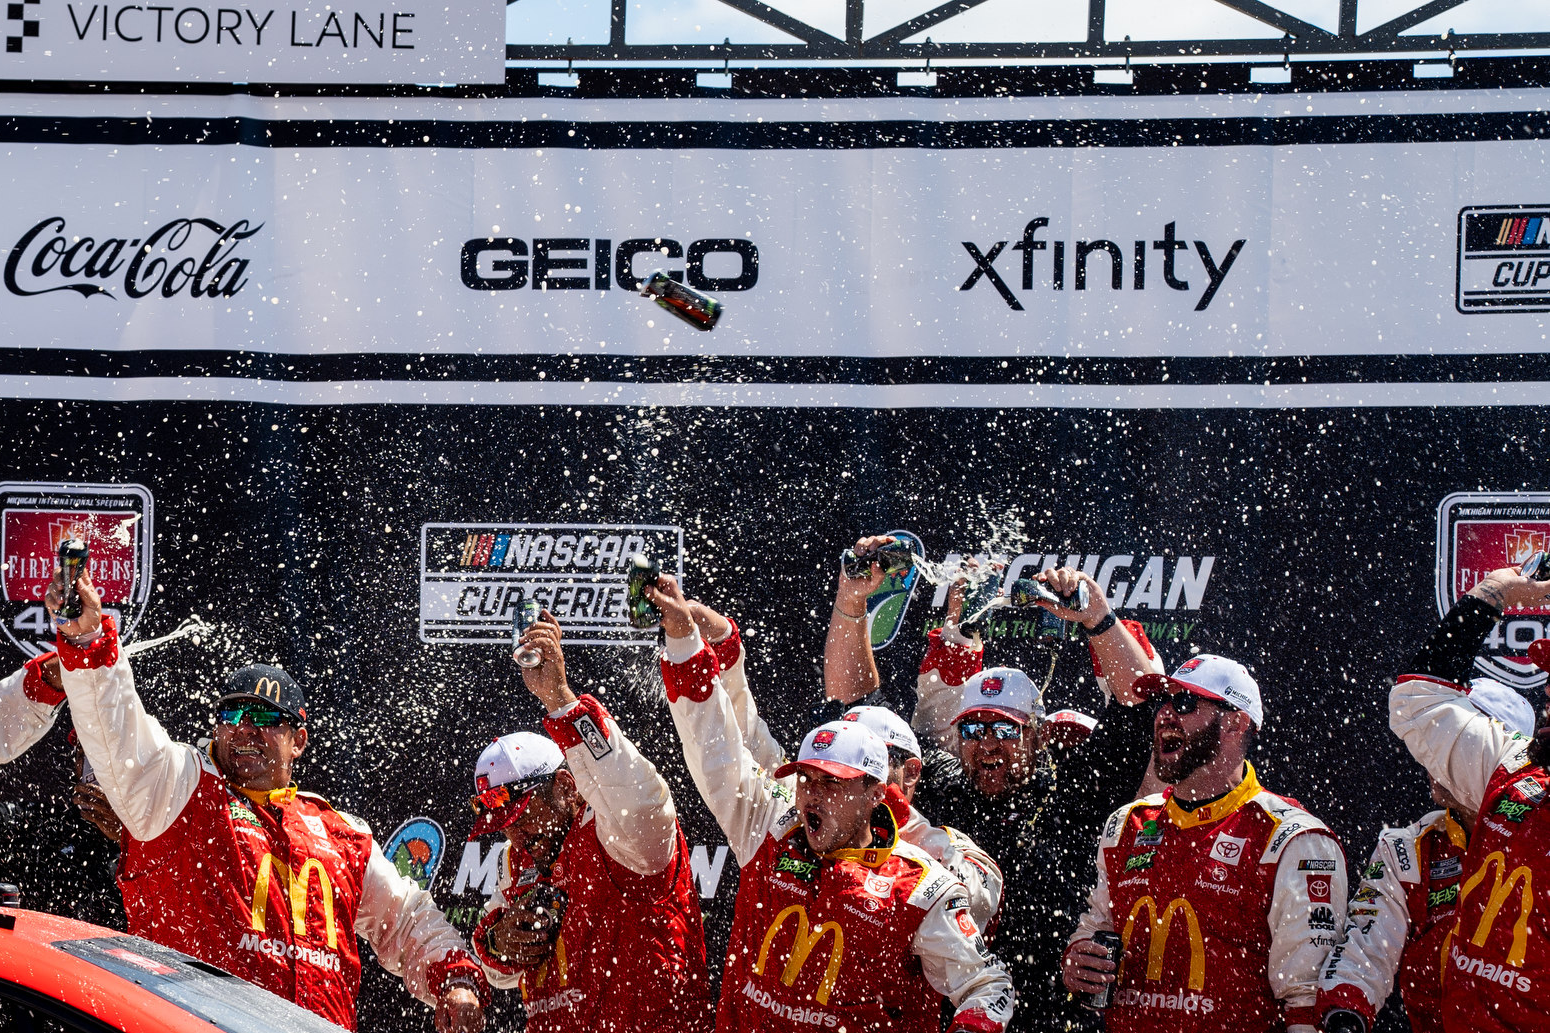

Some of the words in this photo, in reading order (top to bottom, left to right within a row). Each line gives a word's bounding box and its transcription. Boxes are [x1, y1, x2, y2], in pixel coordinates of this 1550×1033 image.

[68, 4, 274, 46] VICTORY
[291, 11, 415, 49] LANE
[3, 216, 266, 300] Coca-Cola
[460, 237, 760, 291] GEICO
[959, 216, 1247, 311] xfinity
[1493, 507, 1550, 516] INTERNATIONA
[503, 534, 646, 568] NASCAR
[529, 585, 631, 618] SERIE
[1496, 799, 1532, 817] BEAST
[775, 856, 819, 875] BEAST
[1309, 860, 1336, 871] NASCAR
[768, 875, 808, 897] GOODYEAR
[1194, 879, 1241, 896] MoneyLion
[741, 980, 838, 1028] McDonald's
